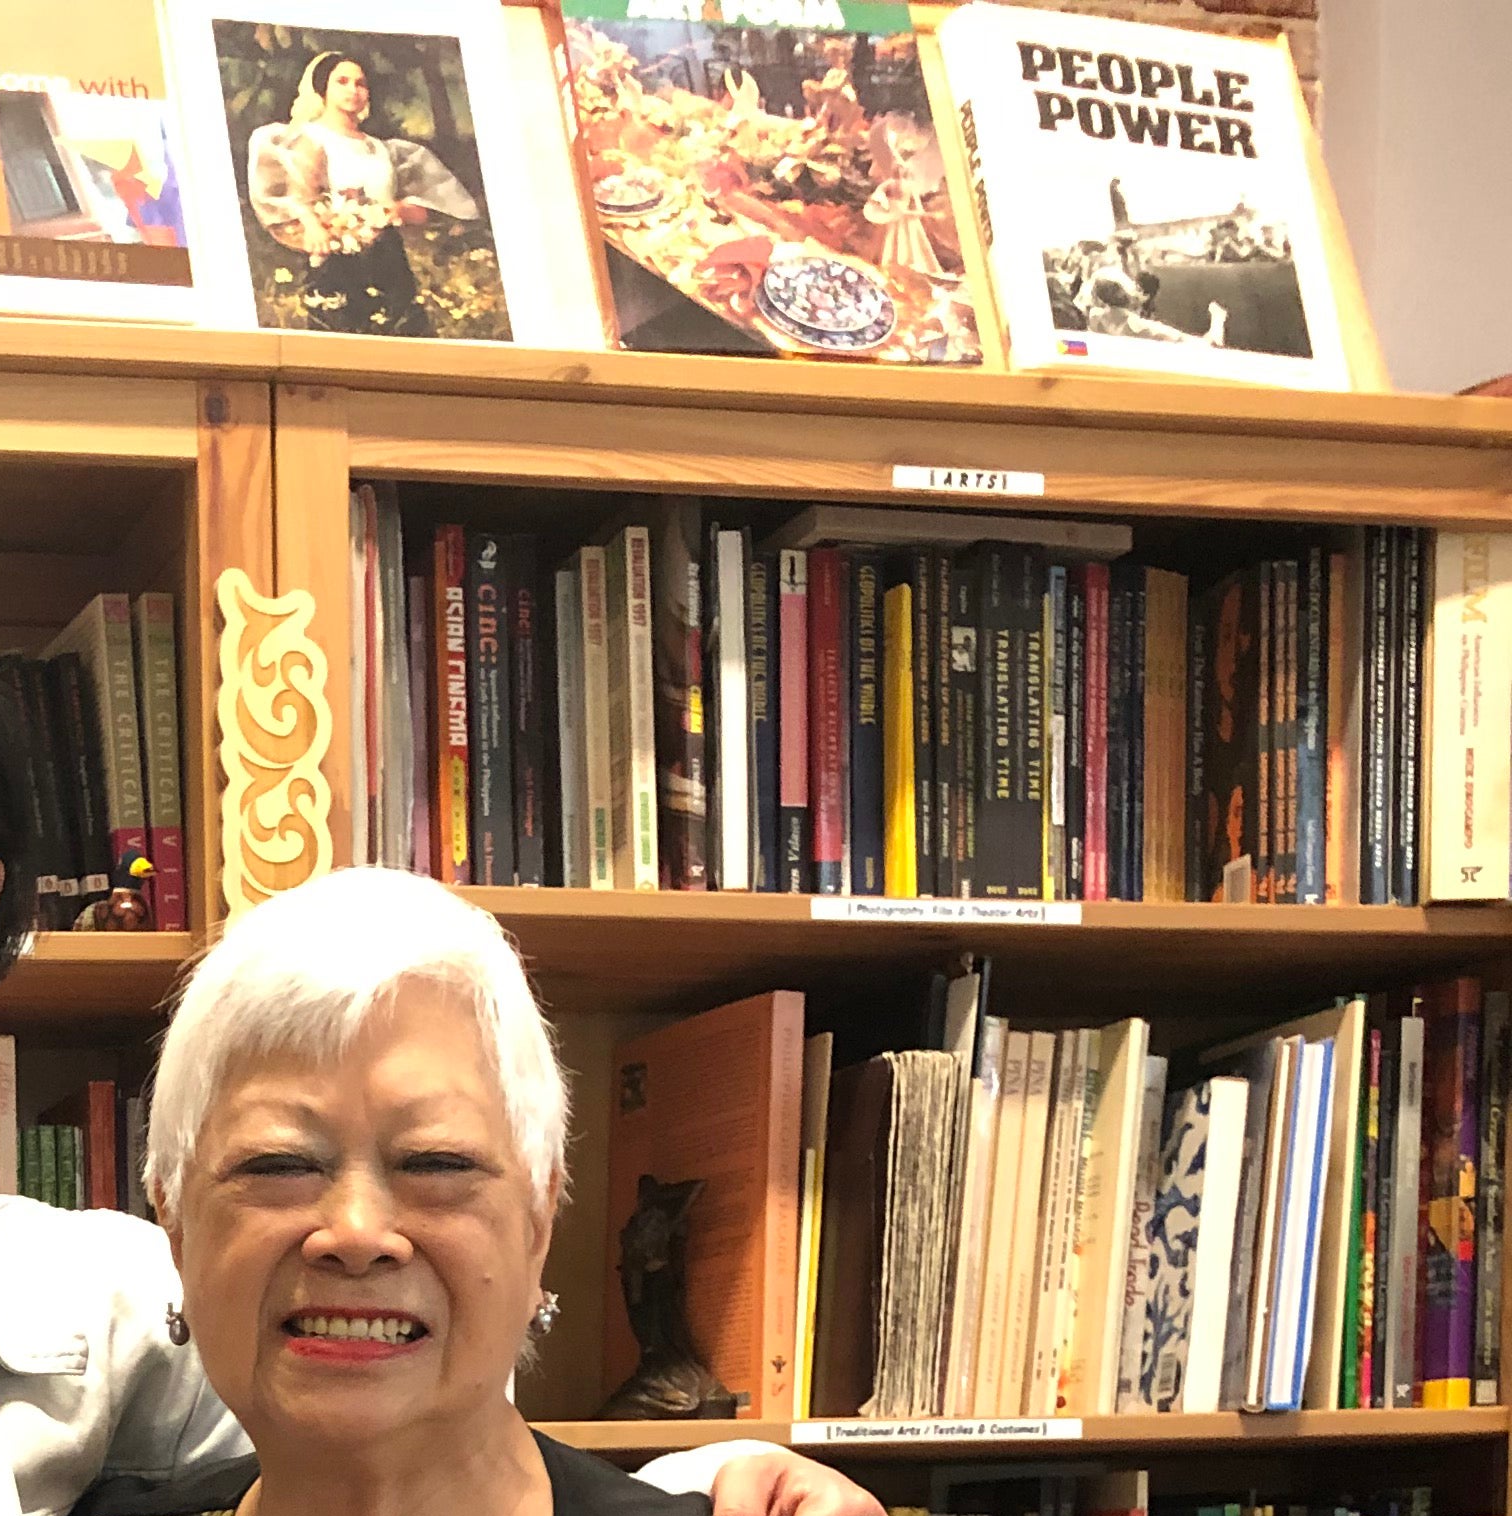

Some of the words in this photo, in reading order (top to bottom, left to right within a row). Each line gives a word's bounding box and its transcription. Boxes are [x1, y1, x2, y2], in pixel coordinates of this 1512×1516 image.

[79, 77, 150, 100] with
[1016, 40, 1254, 113] PEOPLE
[1034, 89, 1258, 159] POWER
[943, 471, 999, 490] ARTS
[1462, 536, 1489, 624] FILM
[446, 587, 464, 652] ASIAN
[114, 660, 129, 699] THE
[154, 659, 170, 697] THE
[447, 659, 468, 747] CINEMA
[997, 630, 1010, 747] TRANSLATING
[1028, 631, 1041, 749] TRANSLATING
[116, 712, 139, 819] CRITICAL
[156, 711, 174, 816] CRITICAL
[997, 757, 1010, 800] TIME
[1027, 760, 1041, 801] TIME
[857, 904, 924, 917] Photography
